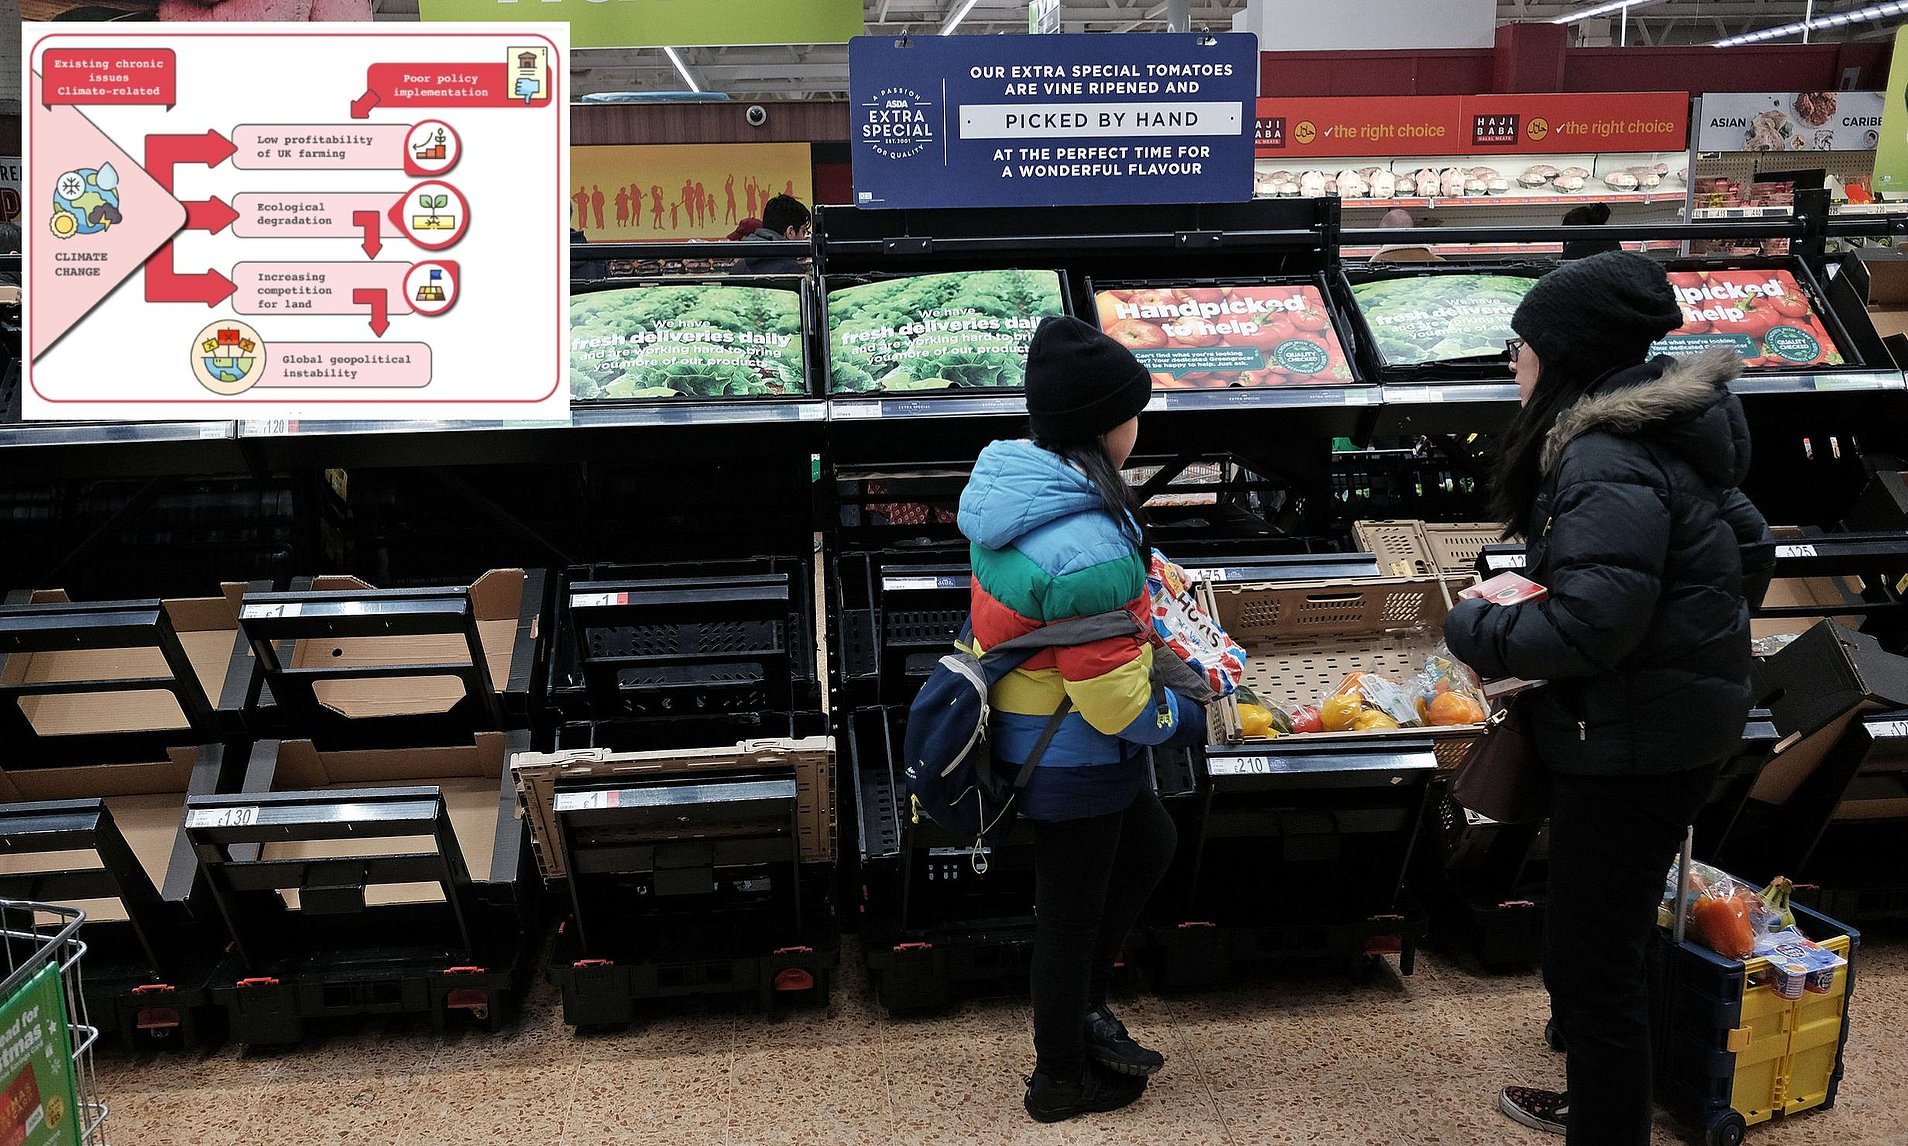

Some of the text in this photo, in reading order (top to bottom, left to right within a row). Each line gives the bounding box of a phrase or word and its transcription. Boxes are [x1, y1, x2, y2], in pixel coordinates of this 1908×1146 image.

[970, 63, 1234, 79] OUR EXTRA SPECIAL TOMATOES
[880, 87, 921, 101] PASSION
[1004, 80, 1200, 96] ARE VINE RIPENED AND
[885, 100, 909, 109] ASDA
[869, 110, 925, 123] EXTRA
[1005, 111, 1199, 129] PICKED BY HAND
[1477, 117, 1513, 126] HAJI
[1710, 117, 1747, 128] ASIAN
[862, 123, 933, 137] SPECIAL
[1255, 120, 1280, 129] AJI
[1333, 123, 1446, 141] the right choice
[1477, 127, 1514, 135] BABA
[1565, 119, 1675, 137] the right choice
[1255, 130, 1281, 138] ABA
[872, 143, 924, 160] FOR QUALITY
[993, 145, 1210, 161] AT THE PERFECT TIME FOR
[1001, 163, 1202, 178] A WONDERFUL FLAVOUR
[1673, 279, 1785, 304] picked
[918, 307, 976, 319] We have
[1114, 294, 1305, 320] Handpicked
[1432, 305, 1517, 318] deliverie
[1684, 305, 1745, 322] help
[652, 319, 711, 328] We have
[842, 315, 1042, 345] fresh deliveries dail
[1161, 319, 1259, 337] to help
[571, 330, 792, 350] fresh deliveries daily
[851, 331, 1035, 355] and are working hard to bri
[579, 350, 605, 360] and
[635, 344, 690, 355] working
[694, 345, 725, 354] hard
[728, 346, 743, 354] to
[746, 346, 782, 358] bring
[893, 350, 930, 361] more
[934, 346, 948, 356] of
[951, 346, 974, 355] our
[977, 344, 1030, 355] product
[1155, 351, 1171, 359] find
[1193, 351, 1214, 359] you're
[1215, 350, 1243, 359] looking
[1209, 355, 1254, 363] Greengrocer
[621, 358, 658, 368] more
[662, 356, 677, 365] of
[680, 357, 704, 365] our
[1164, 362, 1186, 370] happy
